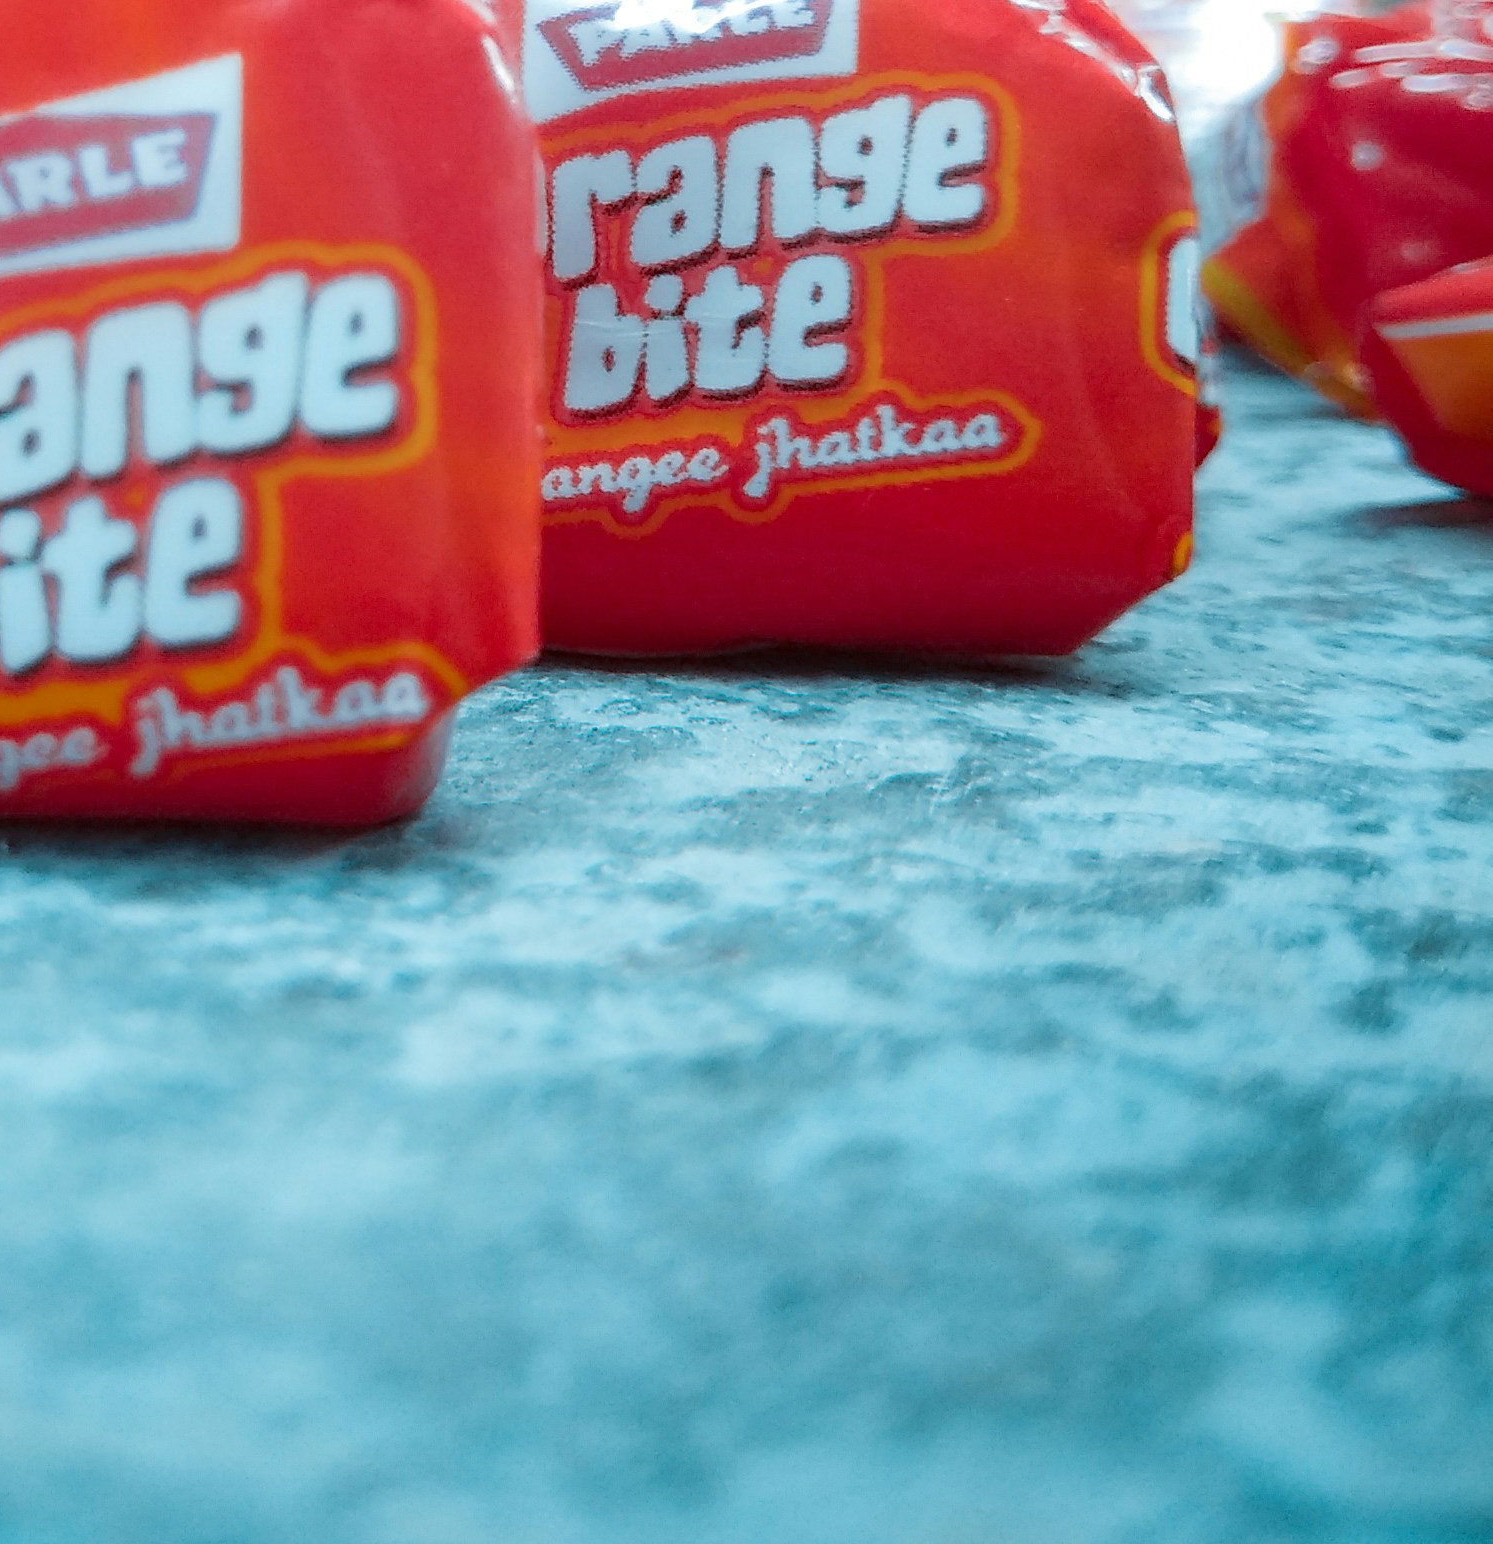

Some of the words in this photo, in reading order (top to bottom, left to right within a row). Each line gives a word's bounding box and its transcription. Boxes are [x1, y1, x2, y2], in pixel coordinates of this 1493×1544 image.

[535, 93, 989, 281] range
[562, 254, 854, 413] bite
[541, 447, 729, 513] angee
[742, 404, 1005, 498] jhatkaa
[128, 664, 428, 778] jhatkaa
